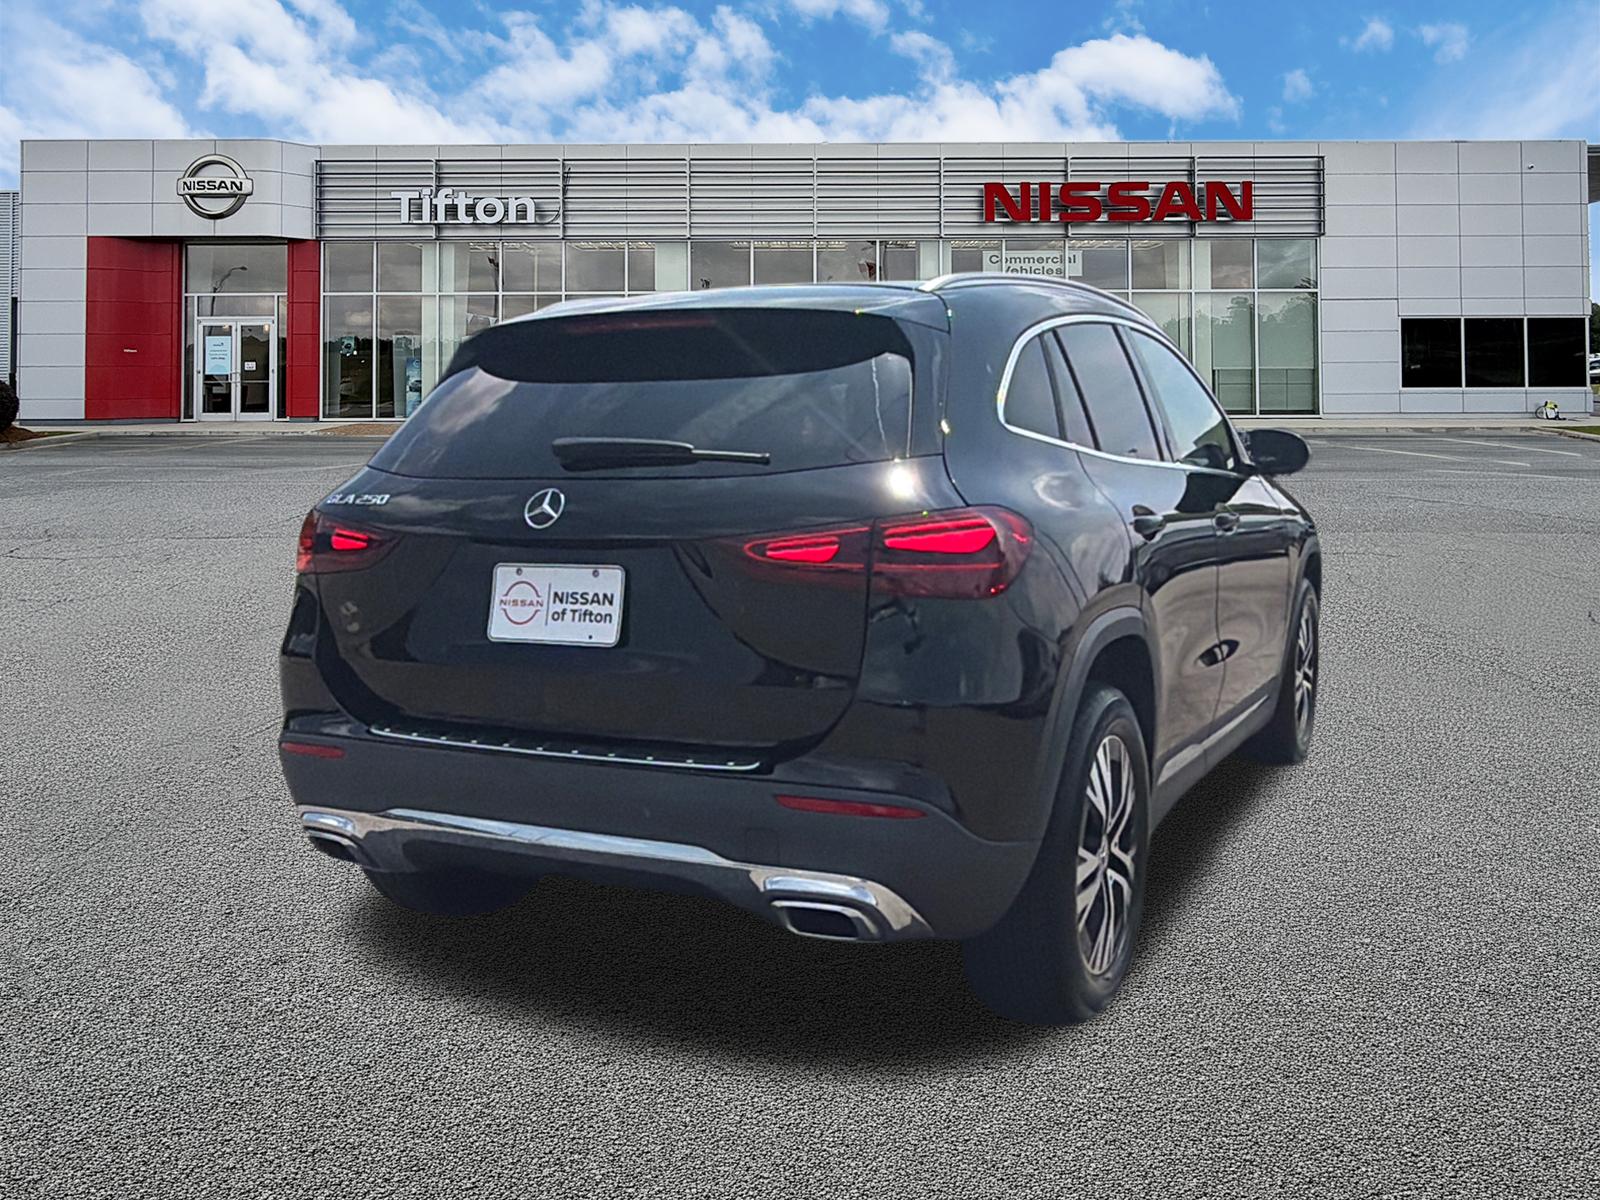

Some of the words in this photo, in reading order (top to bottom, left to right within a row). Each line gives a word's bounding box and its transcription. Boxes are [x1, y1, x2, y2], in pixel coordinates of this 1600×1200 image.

[182, 180, 243, 191] NISSAN
[390, 188, 536, 224] Tifton
[983, 181, 1253, 222] NISSAN
[355, 494, 391, 505] 250
[499, 598, 544, 607] NISSAN
[552, 591, 614, 606] NISSAN
[551, 608, 566, 621] of
[570, 609, 613, 624] Tifton
